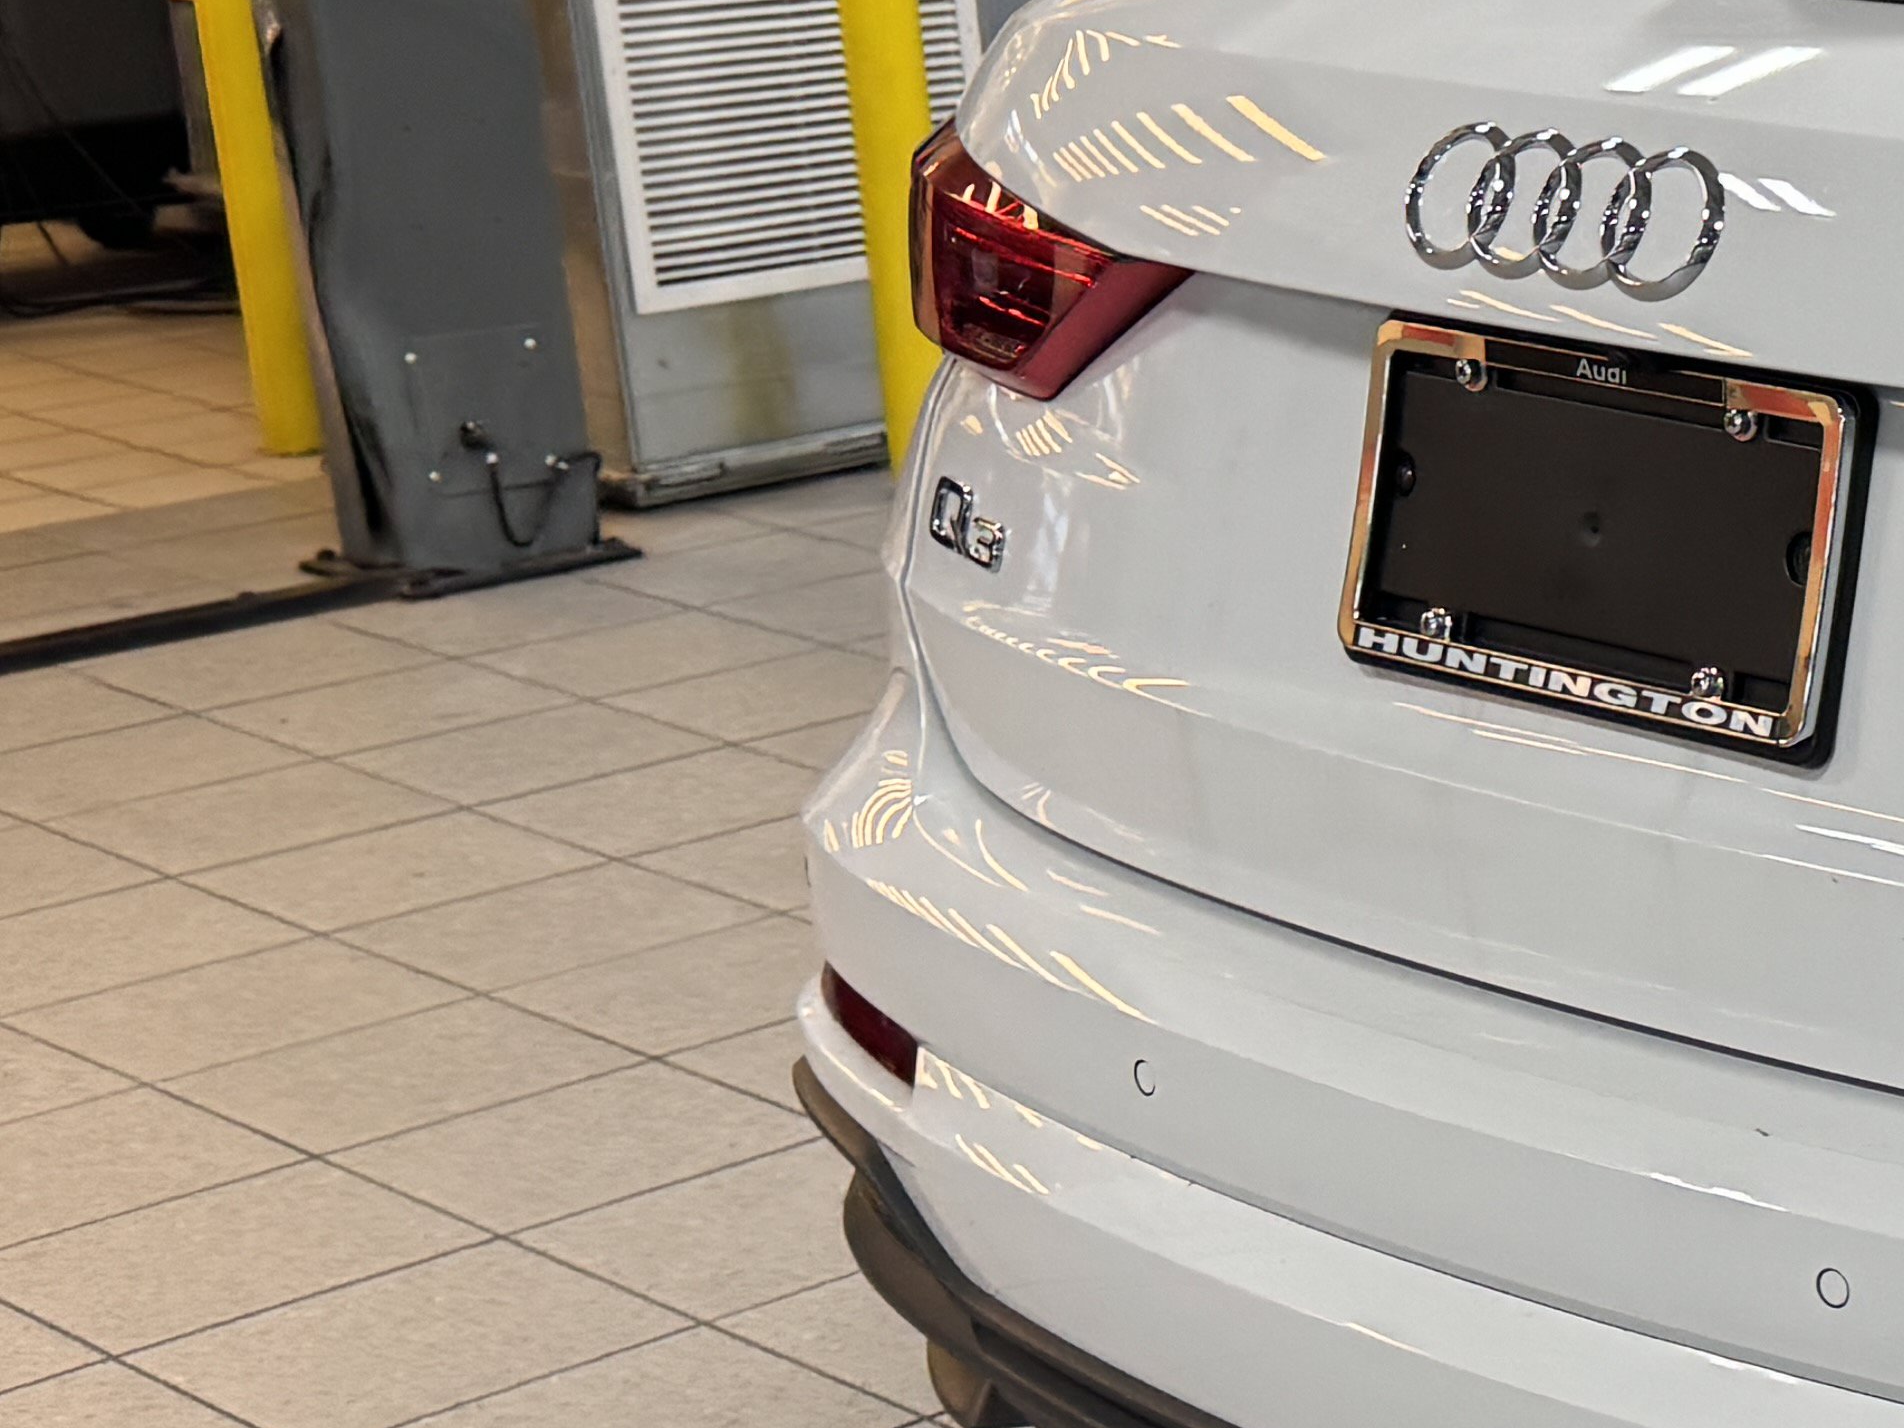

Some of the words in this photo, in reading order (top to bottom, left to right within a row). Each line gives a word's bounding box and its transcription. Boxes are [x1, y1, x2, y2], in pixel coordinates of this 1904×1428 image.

[1576, 358, 1627, 385] Audi
[930, 476, 1005, 573] Q3
[1357, 626, 1776, 738] HUNTINGTON
